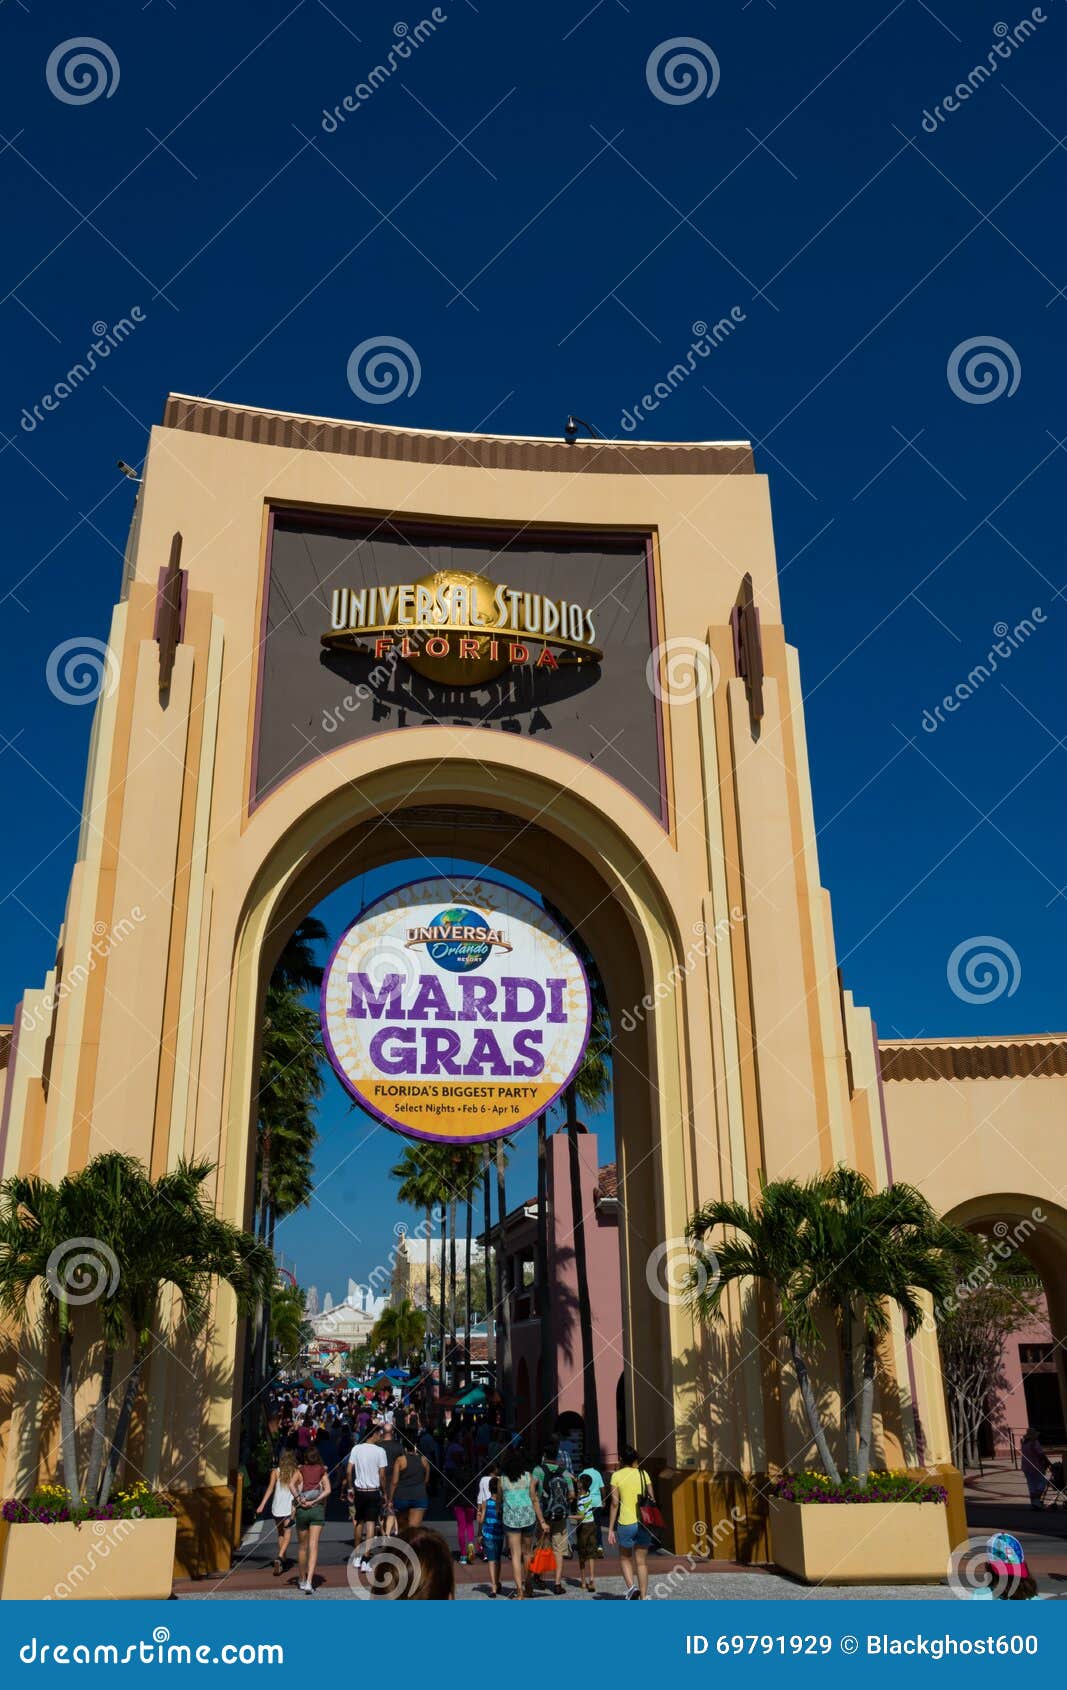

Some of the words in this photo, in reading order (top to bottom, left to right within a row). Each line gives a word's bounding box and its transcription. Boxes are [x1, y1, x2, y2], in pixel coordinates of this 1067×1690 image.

[331, 584, 484, 630] UNIVERSAL
[494, 584, 597, 645] STUDIOS
[374, 636, 559, 670] FLORIDA
[405, 925, 507, 943] UNIVERSAL
[431, 941, 489, 959] Orlando
[346, 972, 568, 1024] MARDI
[369, 1026, 545, 1077] GRAS
[374, 1085, 439, 1097] FLORIDA'S
[442, 1087, 495, 1097] BIGGEST
[498, 1088, 538, 1098] PARTY
[394, 1103, 423, 1113] Select
[425, 1103, 455, 1115] Nights
[462, 1105, 478, 1113] Feb
[480, 1105, 486, 1113] 6
[492, 1105, 508, 1116] Apr
[510, 1105, 520, 1113] 16
